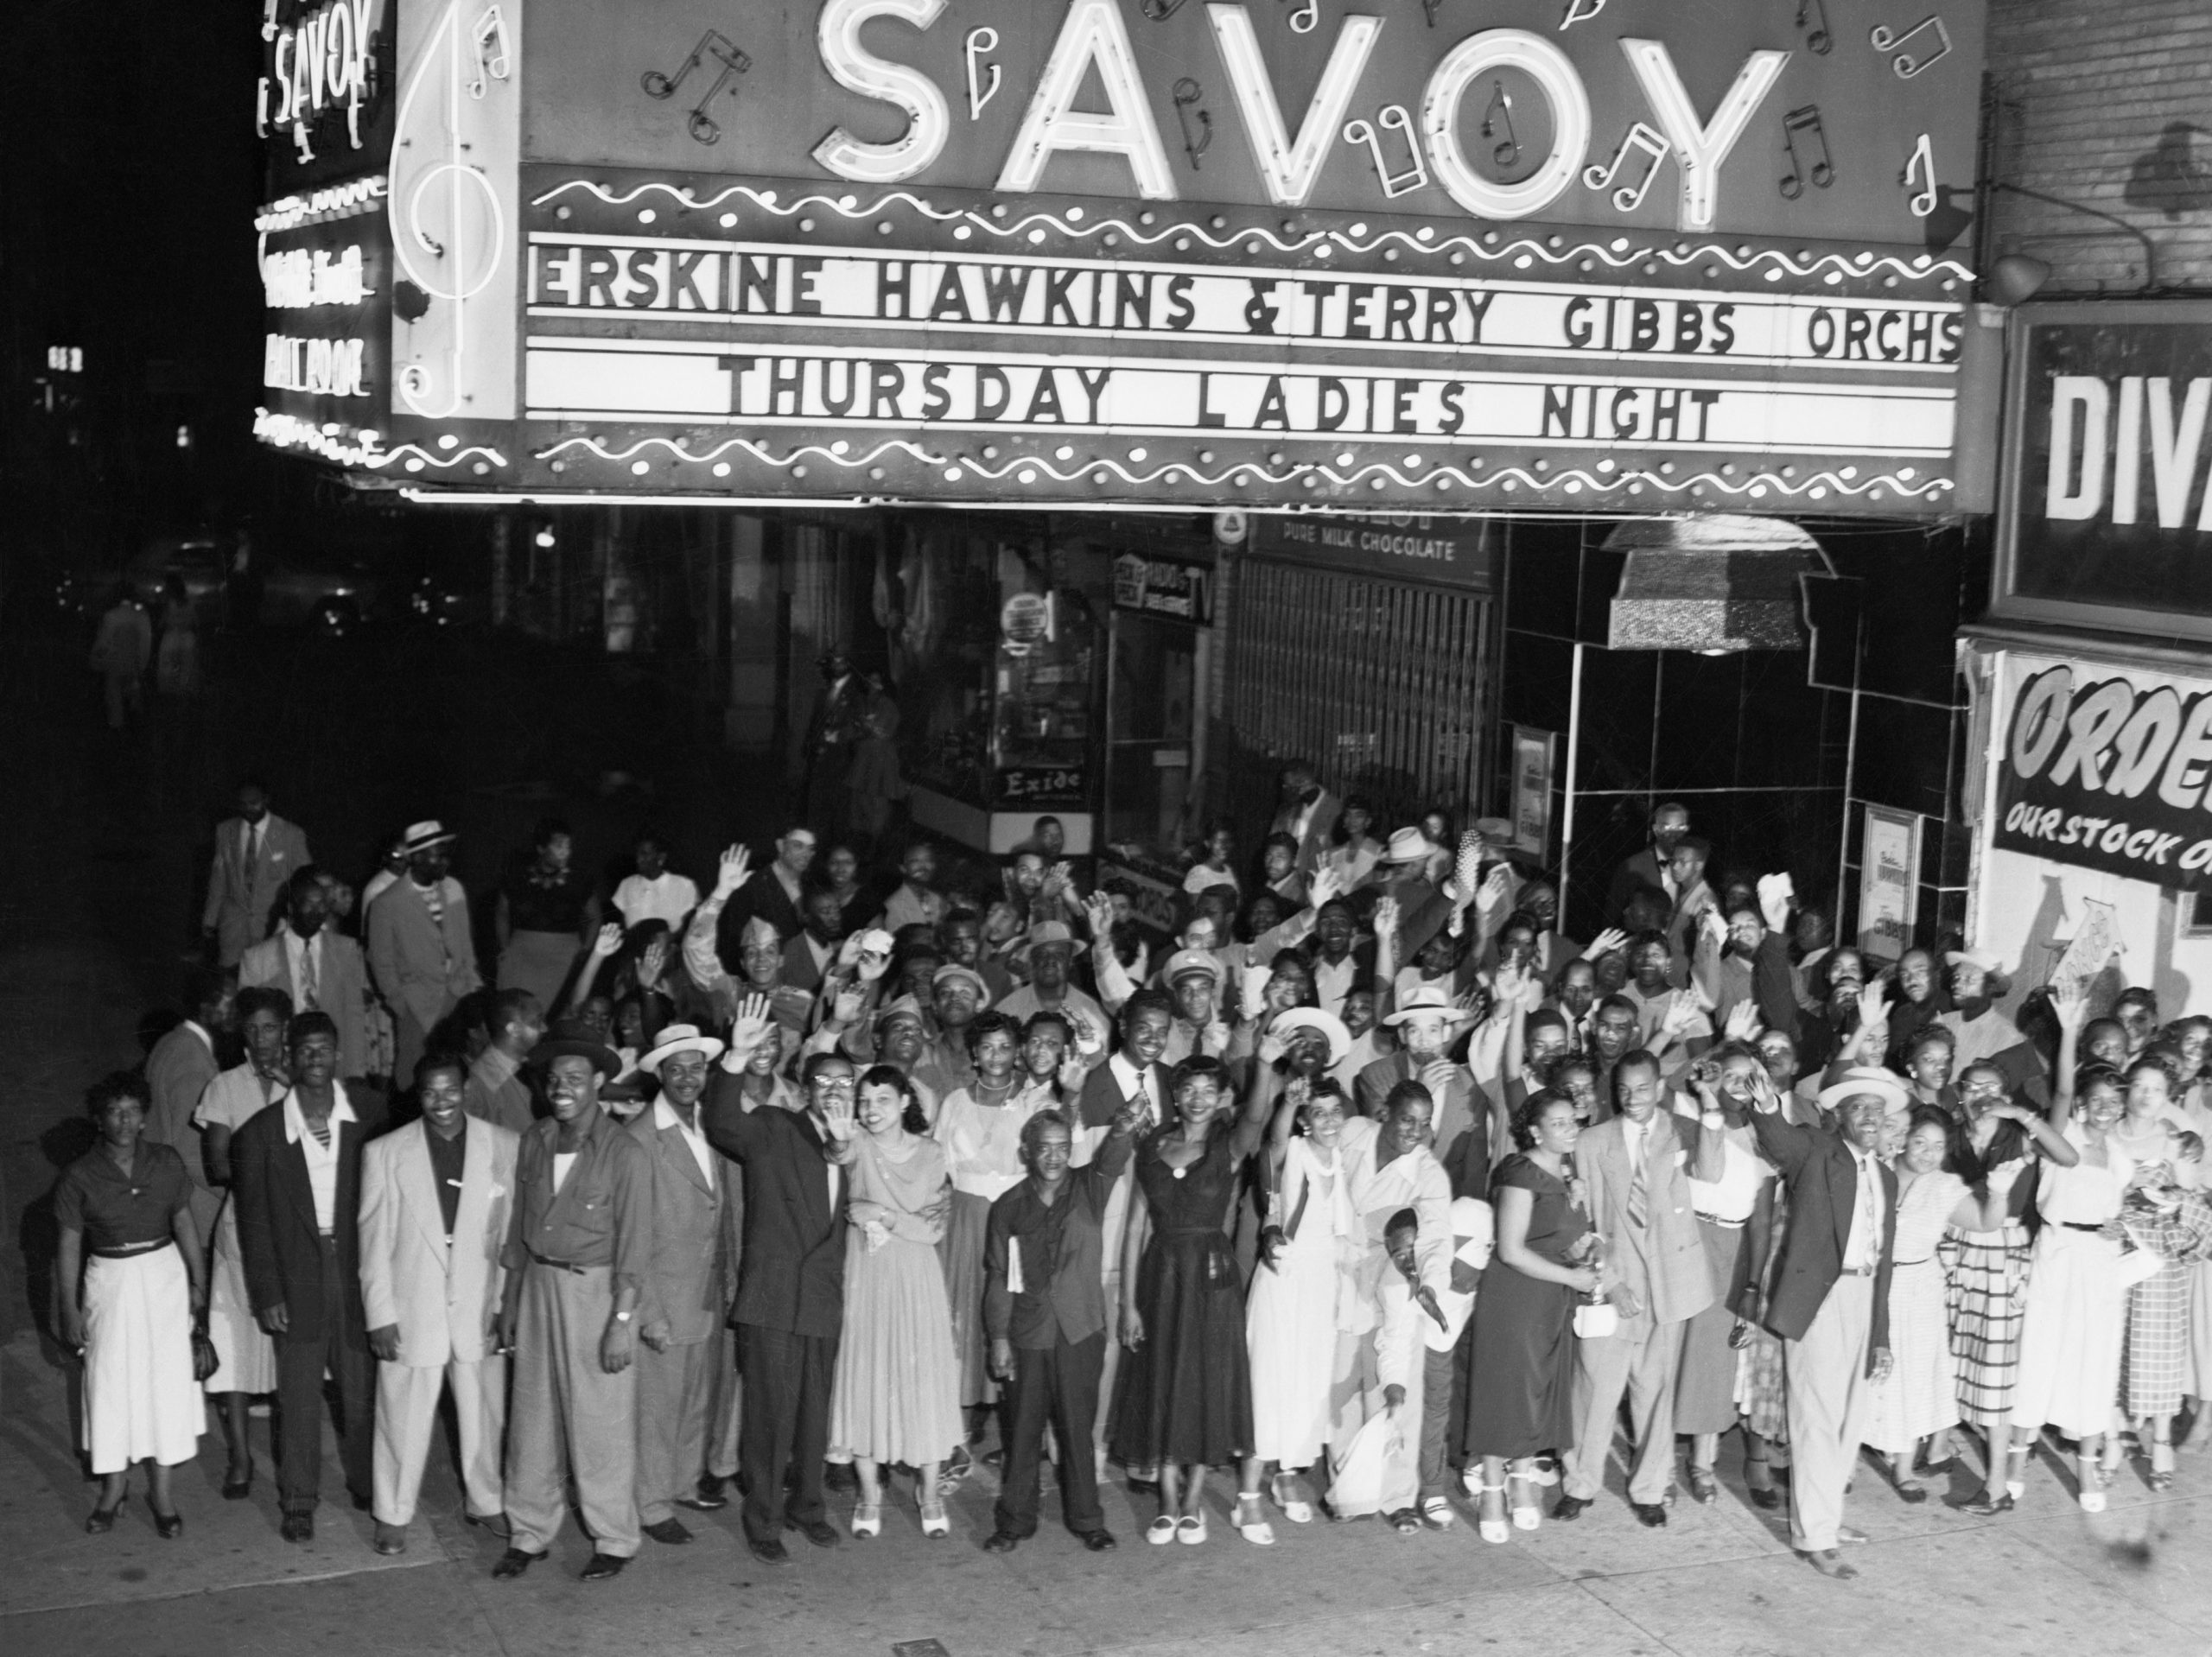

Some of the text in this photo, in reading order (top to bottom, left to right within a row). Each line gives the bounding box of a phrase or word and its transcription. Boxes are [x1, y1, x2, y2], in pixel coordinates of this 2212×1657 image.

[810, 0, 1795, 232] SAVOY
[537, 245, 823, 314] ERSKINE
[877, 260, 1196, 330] HAWKINS
[1303, 283, 1497, 344] TERRY
[1563, 296, 1737, 355] GIBBS
[1808, 307, 1963, 364] ORCHS
[718, 357, 1725, 443] THURSDAY LADIES NIGHT
[2045, 376, 2212, 531] DIV
[1283, 521, 1317, 543] PURE
[1321, 526, 1356, 549] MILK
[1359, 531, 1456, 562] CHOCOLATE
[1004, 770, 1081, 797] Exide
[2006, 663, 2212, 810] ORDE
[2005, 801, 2064, 841] OUR
[2057, 815, 2185, 865] STOCK
